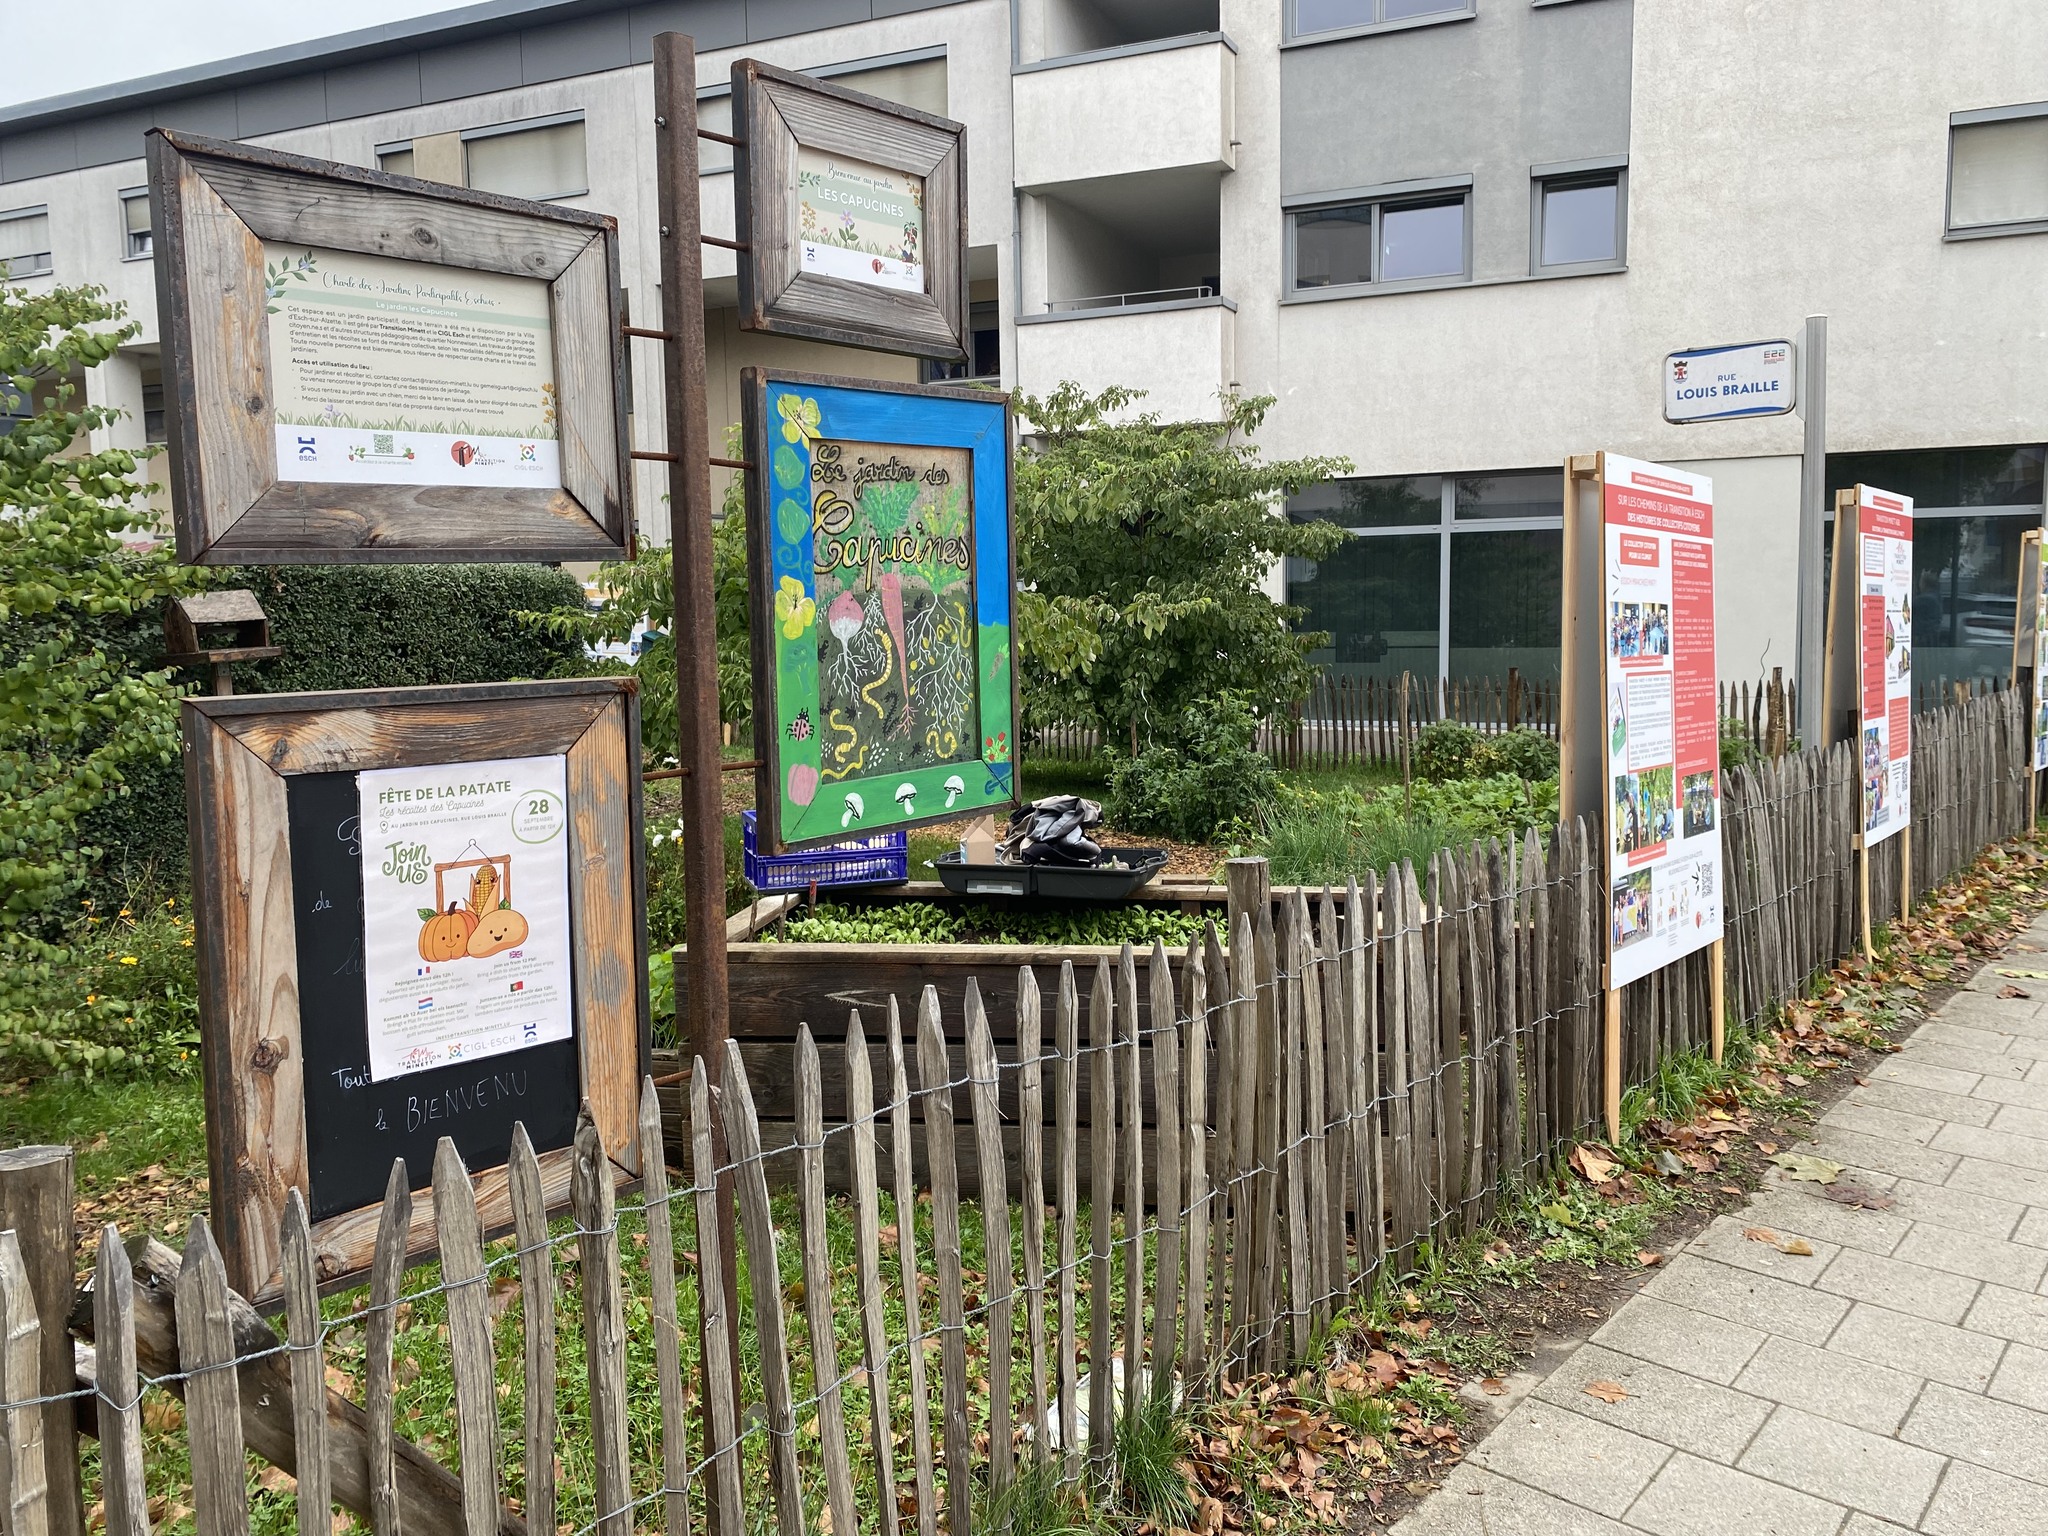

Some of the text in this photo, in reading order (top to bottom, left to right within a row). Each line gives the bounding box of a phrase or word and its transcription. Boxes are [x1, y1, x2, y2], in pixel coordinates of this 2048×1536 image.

[828, 162, 860, 182] Bienvenue
[873, 178, 893, 192] jardin
[818, 187, 904, 217] LES CAPUCINES
[322, 271, 355, 288] Charte
[358, 278, 372, 291] des
[387, 303, 408, 311] jardin
[421, 307, 458, 317] Capucines
[379, 323, 407, 332] Transition
[407, 326, 426, 334] Minett
[437, 329, 452, 337] CIGL
[1718, 374, 1736, 382] RUE
[1677, 380, 1779, 400] LOUIS BRAILLE
[811, 444, 950, 499] Le jardin des
[1617, 493, 1627, 506] SUR
[1628, 495, 1636, 507] LES
[812, 490, 970, 592] Capucines
[379, 781, 511, 804] FÊTE DE LA PATATE
[379, 800, 484, 819] Les récoltes des Capucines
[529, 799, 549, 815] 28
[524, 816, 553, 824] SEPTEMBRE
[381, 840, 432, 877] Join
[396, 862, 429, 885] us
[398, 1054, 441, 1067] TRANSITION
[406, 1060, 433, 1070] MINETT
[407, 1070, 527, 1132] BIENVENU
